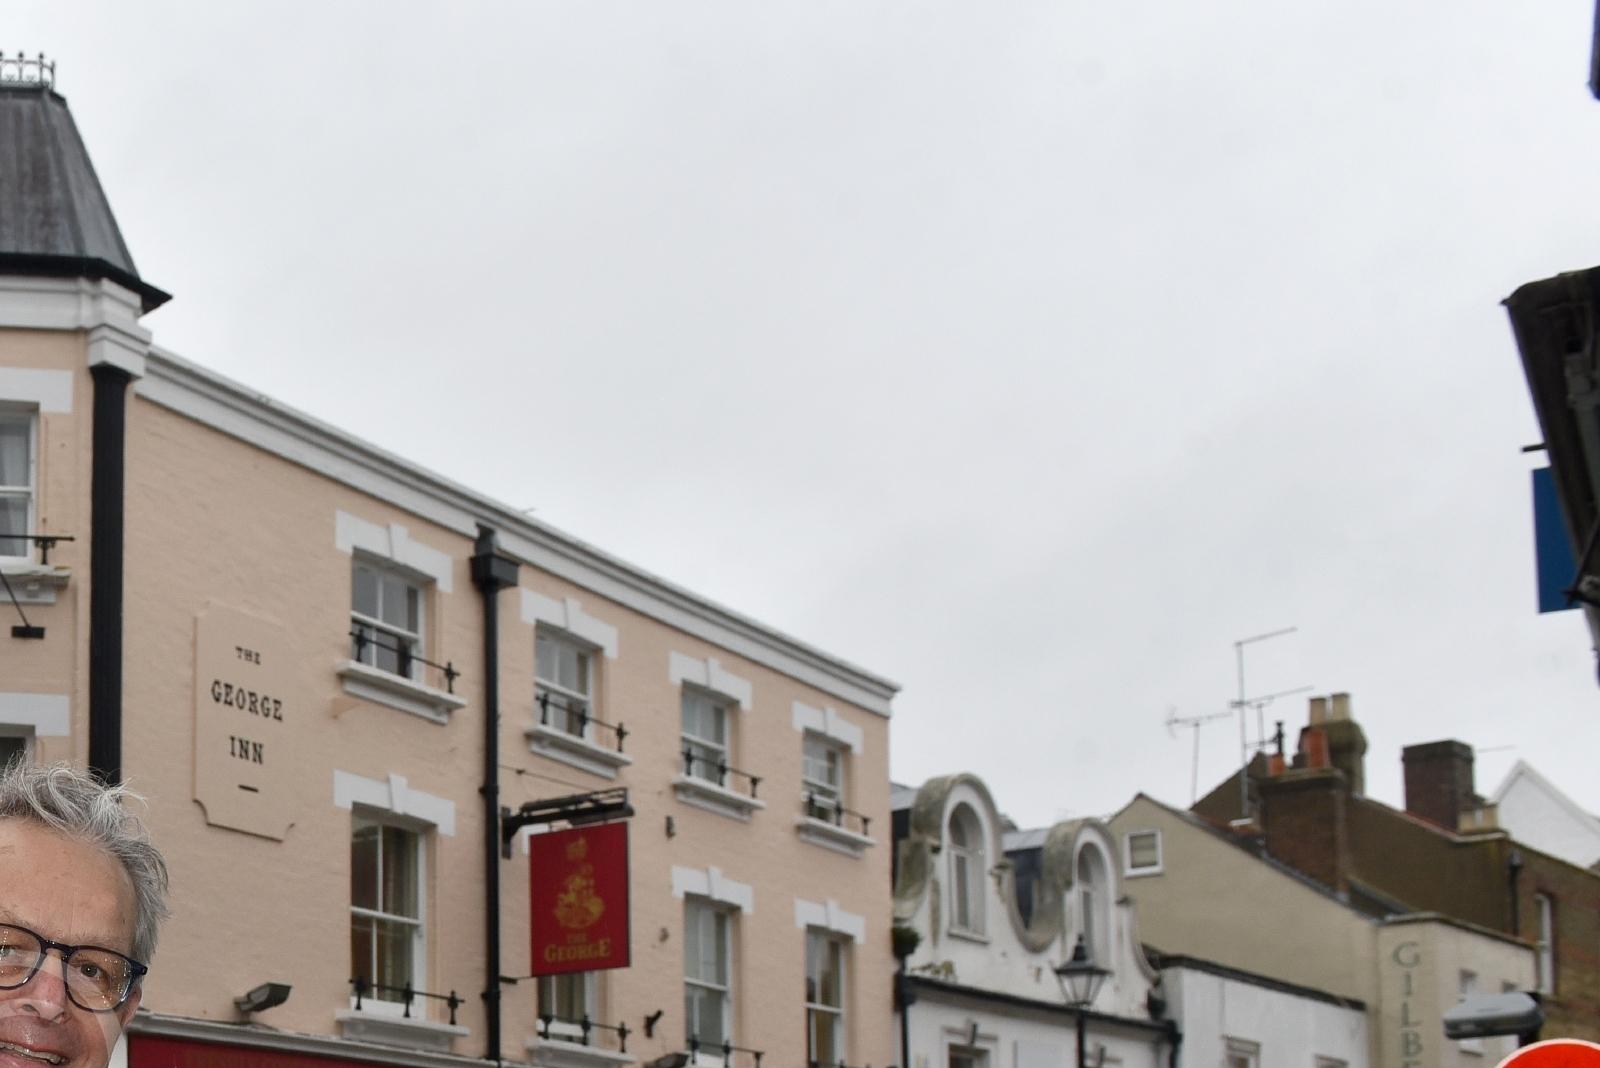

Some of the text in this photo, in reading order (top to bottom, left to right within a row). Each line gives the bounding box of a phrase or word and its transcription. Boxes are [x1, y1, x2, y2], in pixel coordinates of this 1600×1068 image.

[235, 646, 261, 665] THE
[211, 678, 283, 722] GEORGE
[230, 735, 264, 765] INN
[544, 937, 611, 963] GEORGE
